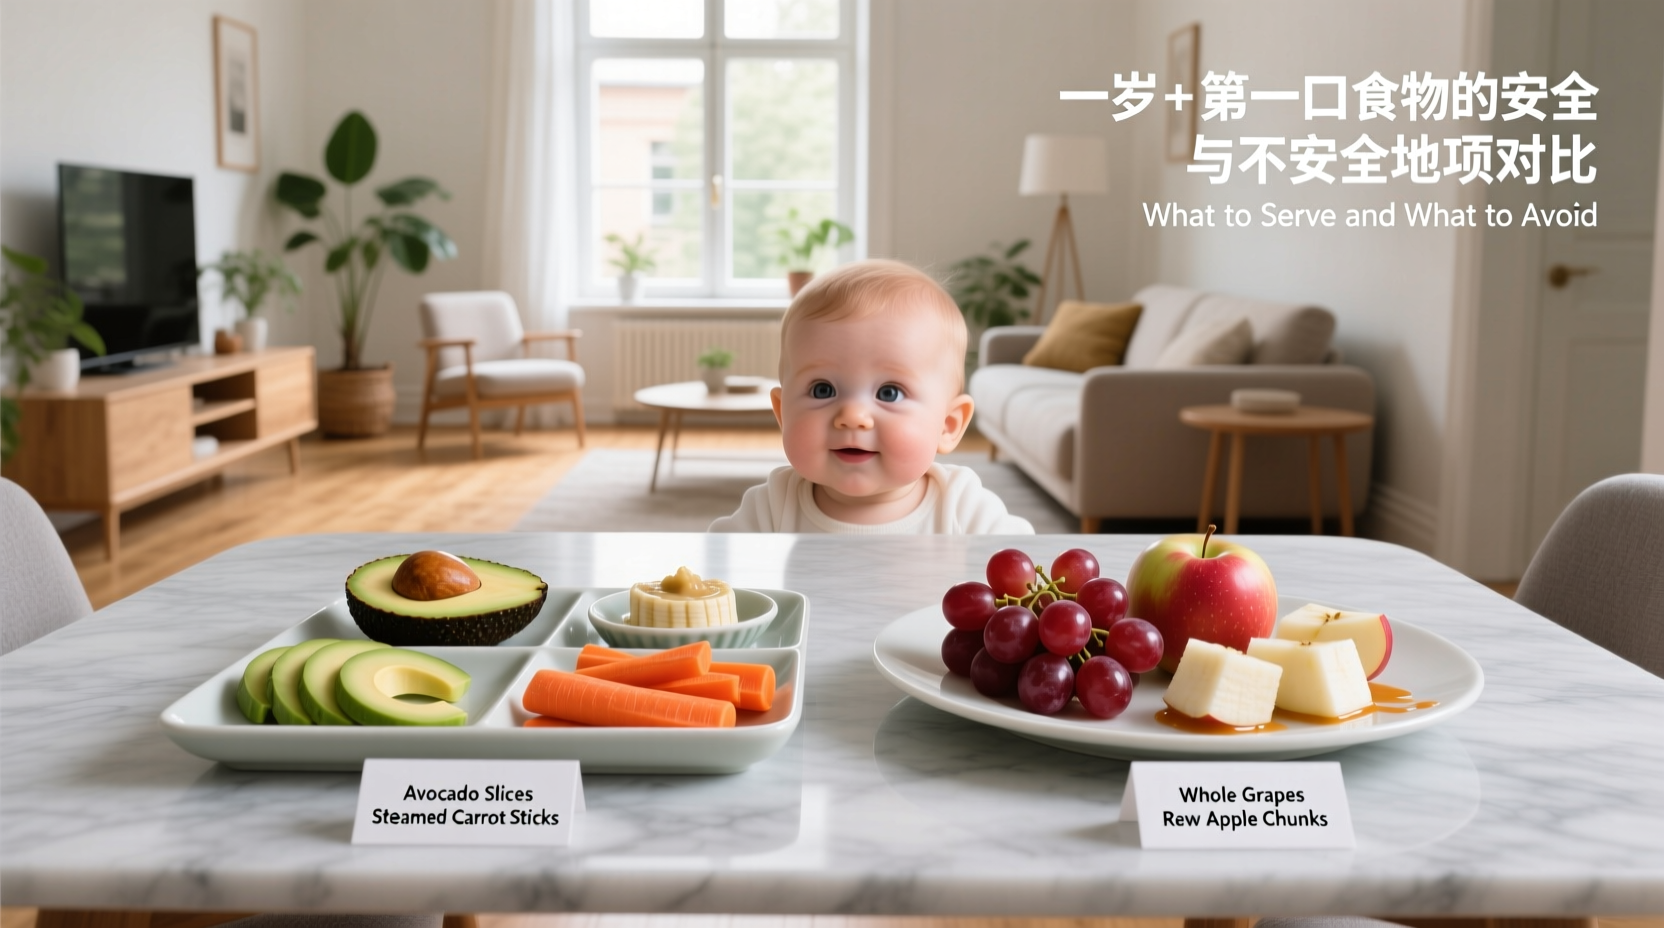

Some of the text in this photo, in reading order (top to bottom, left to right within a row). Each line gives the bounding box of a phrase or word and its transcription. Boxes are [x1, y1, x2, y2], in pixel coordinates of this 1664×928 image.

[403, 784, 533, 802] Avocado Slices
[1178, 786, 1305, 807] Whole Grapes
[372, 808, 559, 826] Steamed Carrot Sticks
[1162, 809, 1329, 831] Rew Apple Chunks
